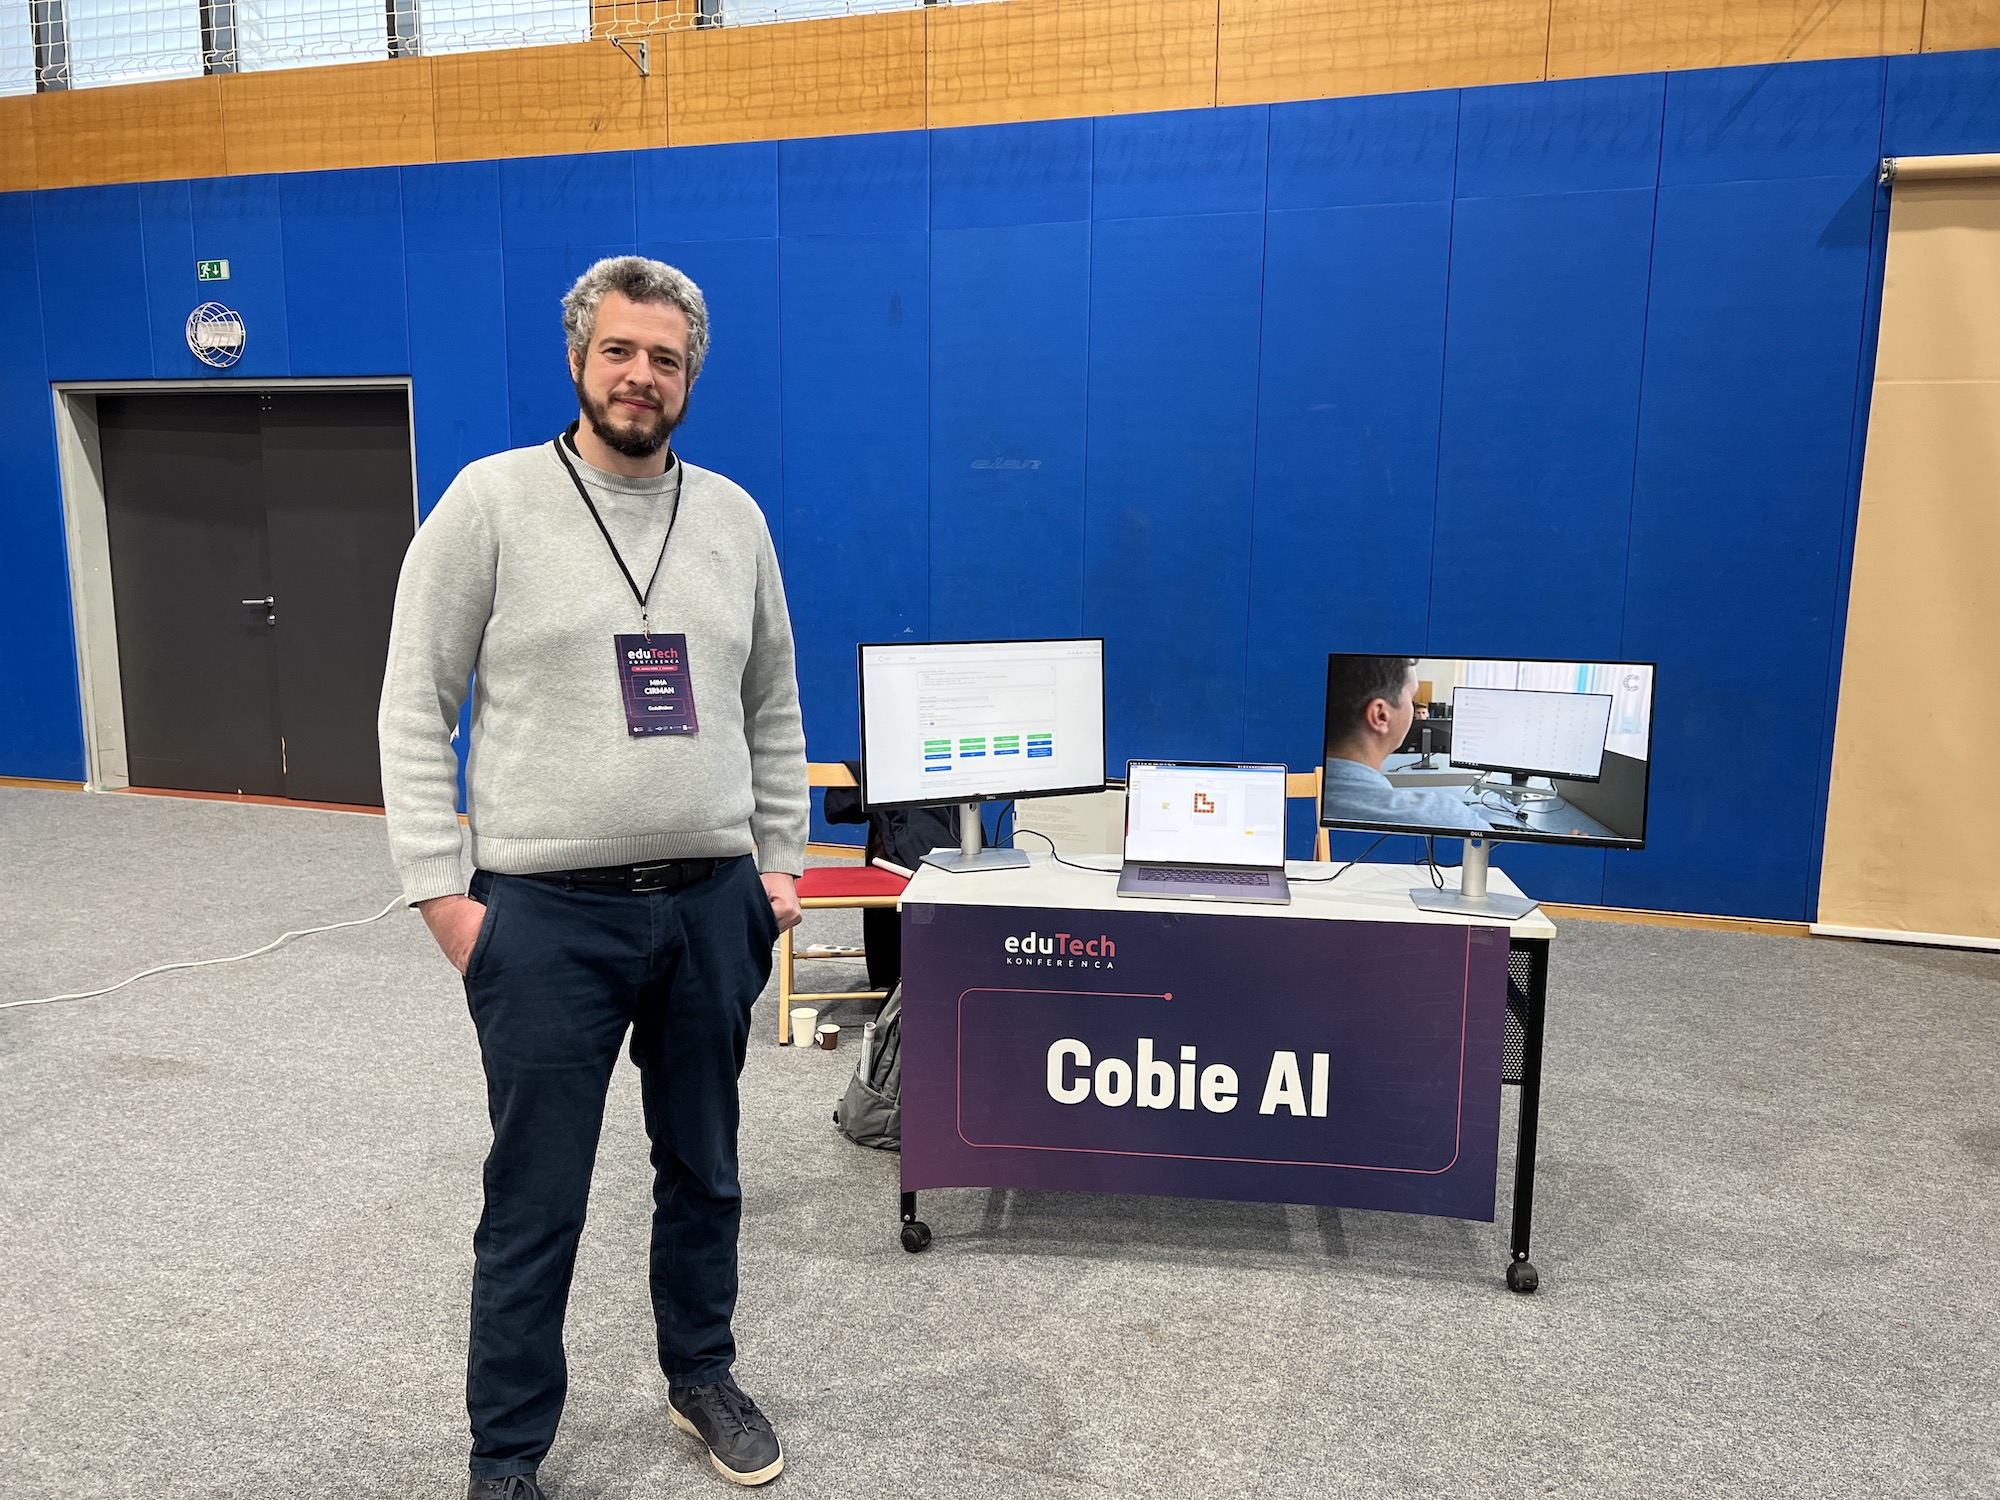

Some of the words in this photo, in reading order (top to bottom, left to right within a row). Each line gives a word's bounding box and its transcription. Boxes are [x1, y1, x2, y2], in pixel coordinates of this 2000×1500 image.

[628, 648, 678, 659] eduTech
[1004, 931, 1116, 957] eduTech
[1006, 957, 1114, 969] KONFERENCA
[1046, 1038, 1239, 1113] Cobie
[1259, 1050, 1330, 1117] AI
